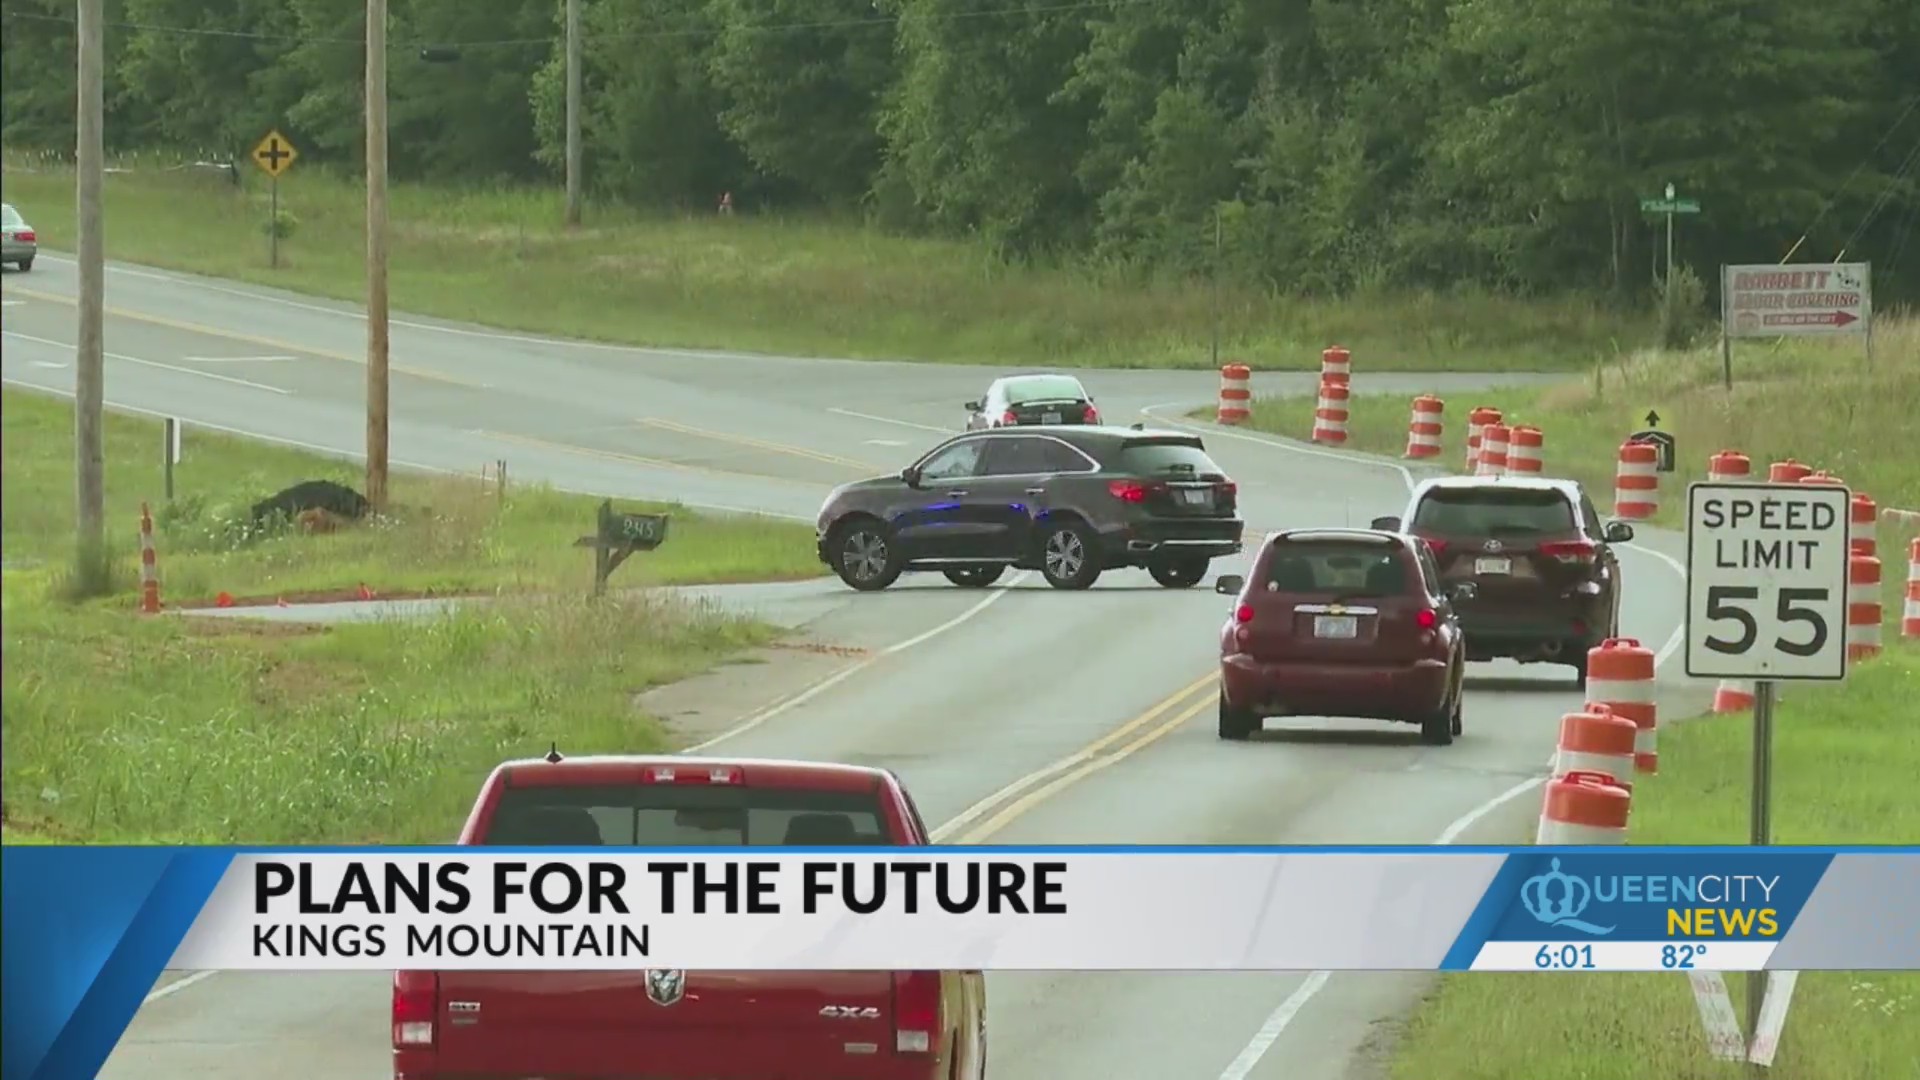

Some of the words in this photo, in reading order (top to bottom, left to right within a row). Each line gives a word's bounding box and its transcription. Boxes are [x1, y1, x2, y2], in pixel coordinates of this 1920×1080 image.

[1703, 499, 1835, 530] SPEED
[1716, 539, 1819, 569] LIMIT
[1704, 586, 1828, 656] 55
